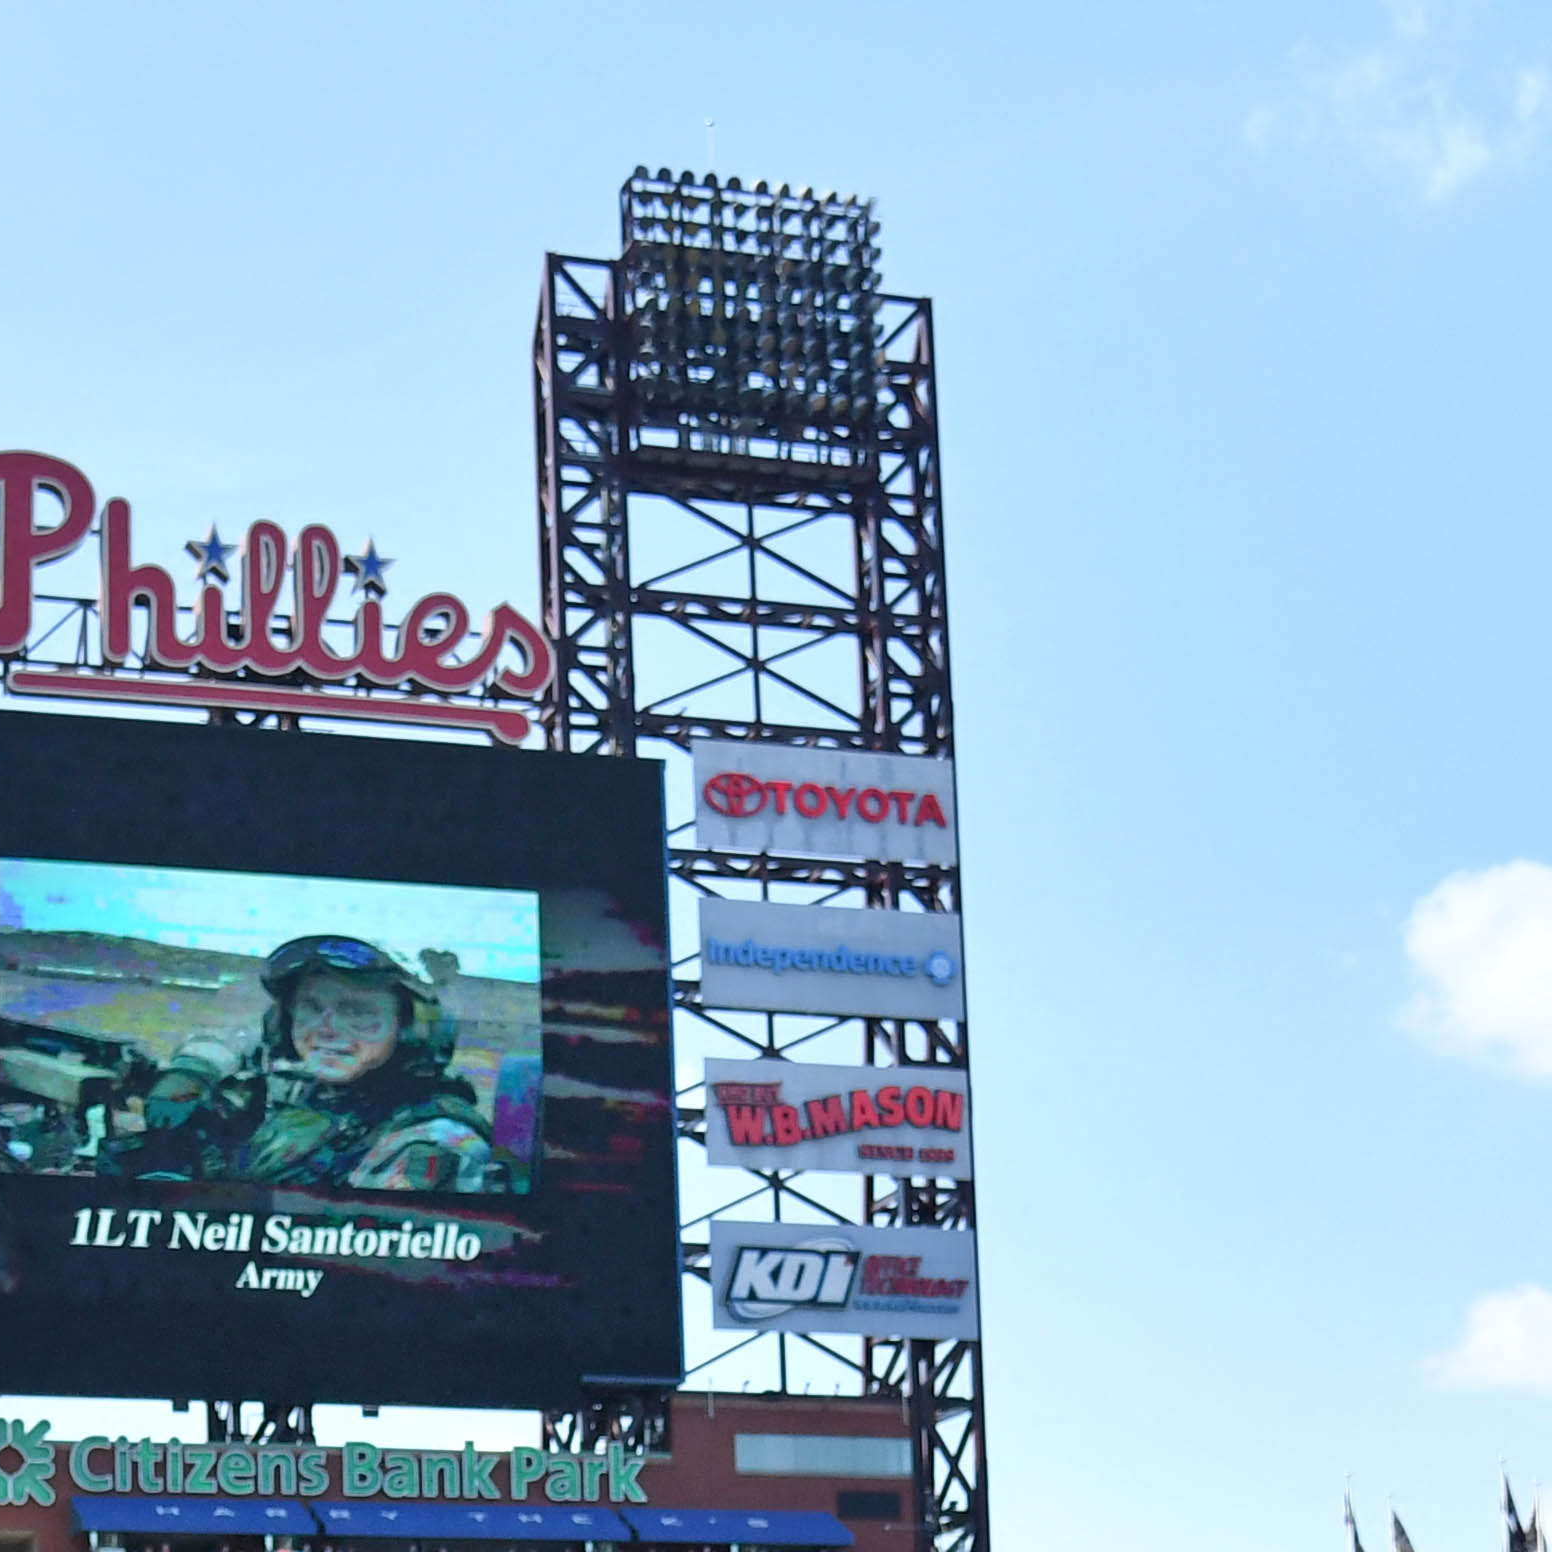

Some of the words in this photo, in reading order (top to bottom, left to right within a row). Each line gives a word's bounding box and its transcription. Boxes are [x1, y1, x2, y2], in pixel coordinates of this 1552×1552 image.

[765, 781, 946, 828] TOYOTA
[70, 1208, 161, 1248] 1LT
[168, 1211, 253, 1252] Neil
[261, 1214, 482, 1261] Santoriello
[236, 1261, 324, 1298] Army
[731, 1250, 857, 1304] KDI
[69, 1436, 329, 1496] Citizens
[342, 1441, 501, 1500] Bank
[512, 1444, 647, 1502] Park
